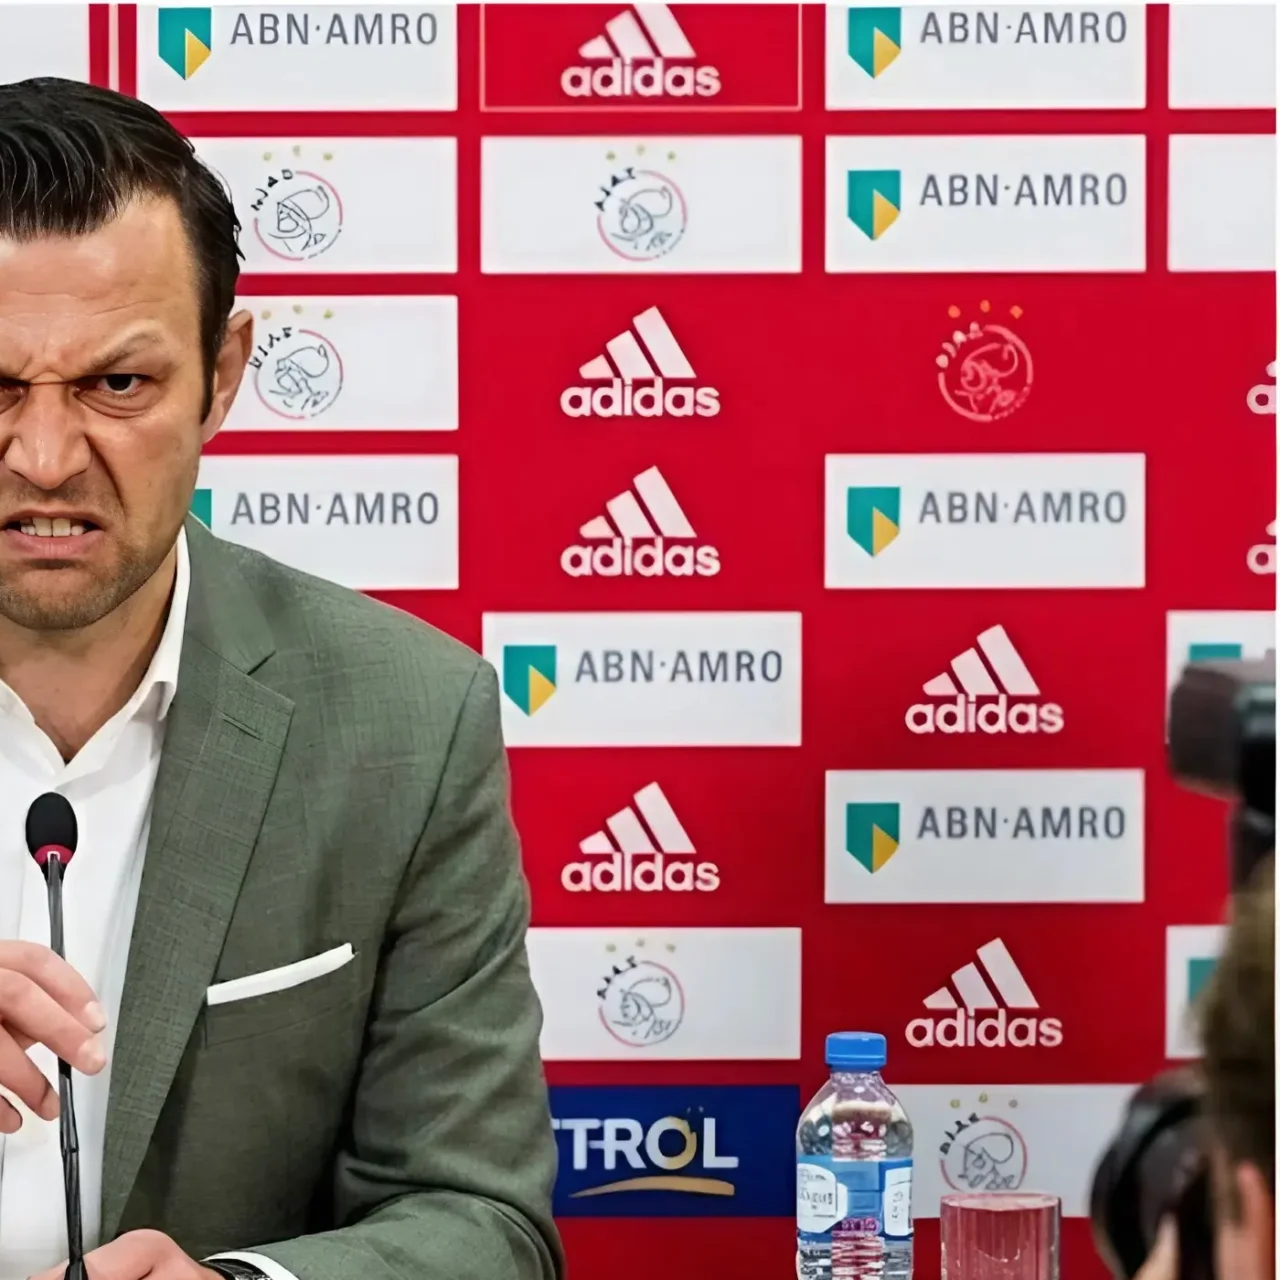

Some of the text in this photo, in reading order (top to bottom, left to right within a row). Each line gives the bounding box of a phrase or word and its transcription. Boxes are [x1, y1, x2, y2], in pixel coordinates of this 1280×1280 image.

[561, 57, 721, 97] adidas
[560, 377, 721, 418] adidas
[560, 537, 721, 577] adidas
[904, 695, 1064, 734] adidas
[561, 854, 720, 892] adidas
[905, 1008, 1063, 1048] adidas
[551, 1116, 739, 1170] TROL
